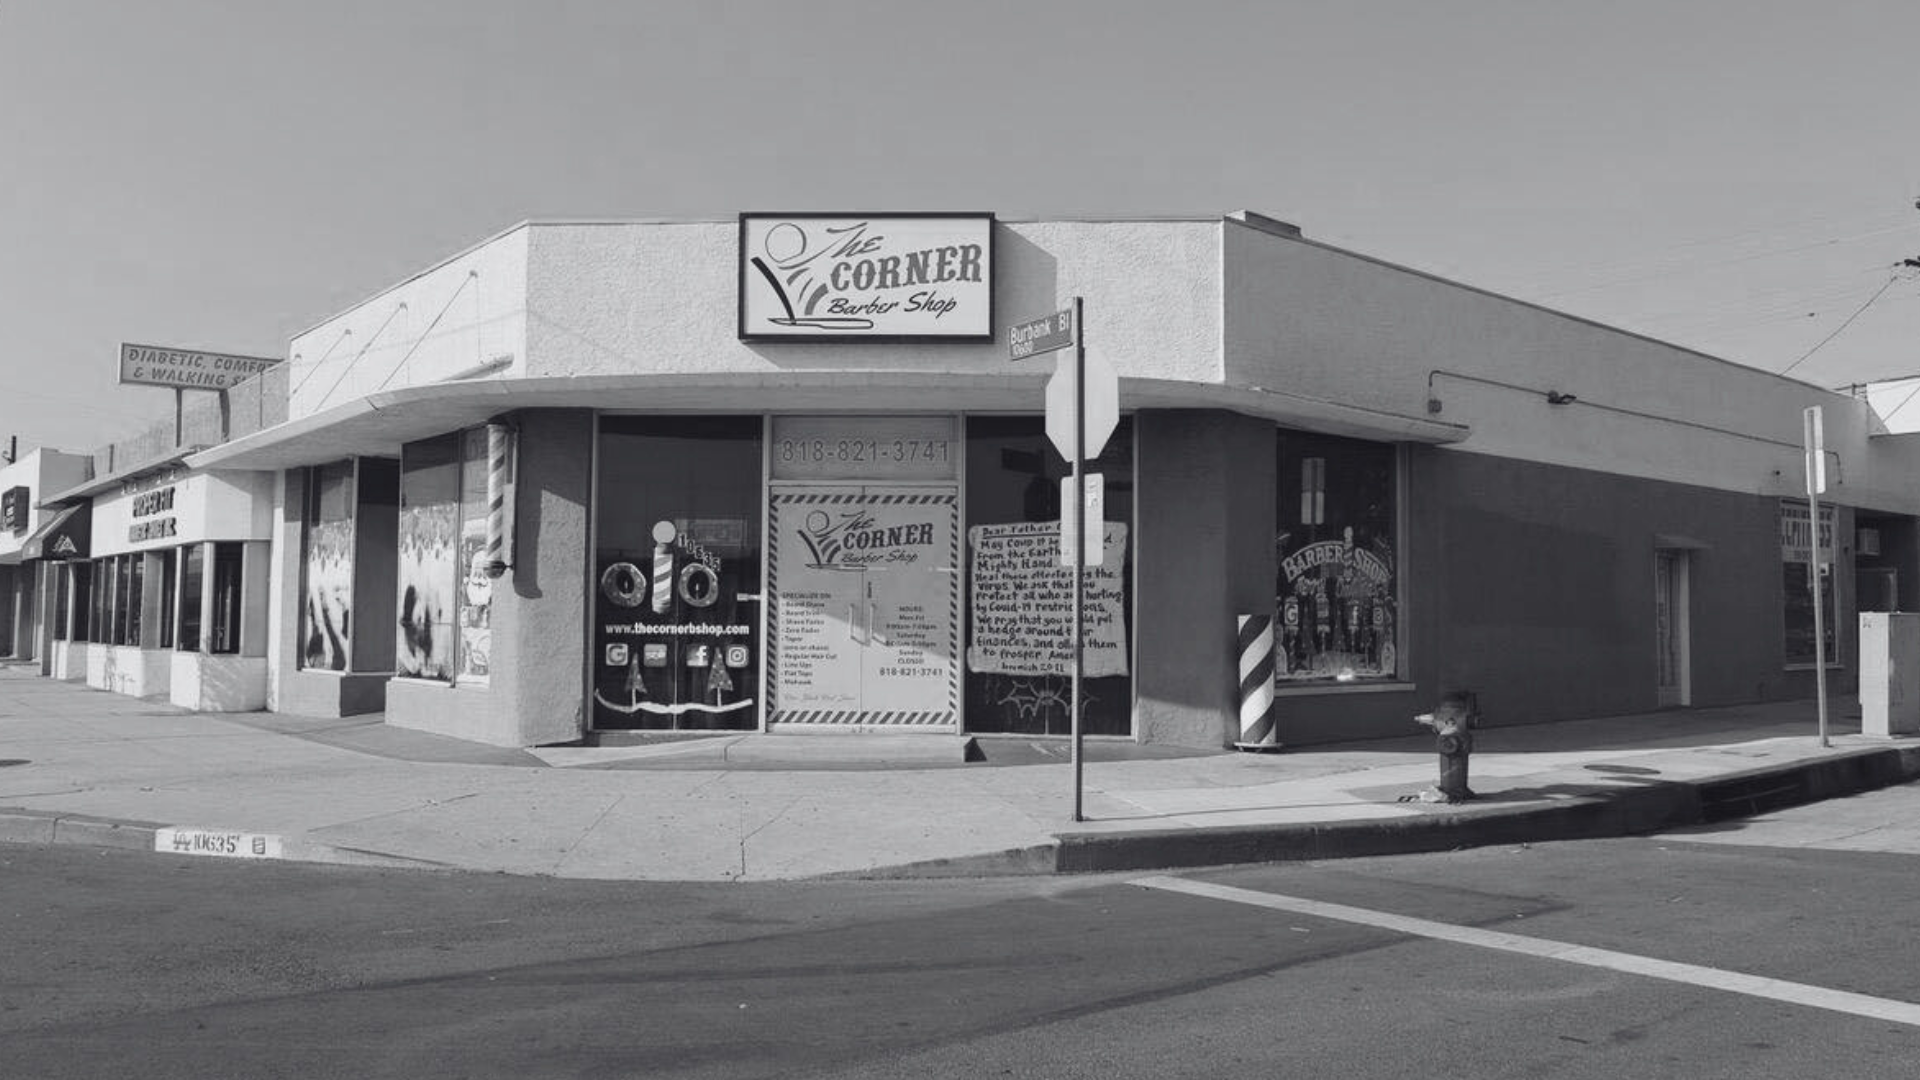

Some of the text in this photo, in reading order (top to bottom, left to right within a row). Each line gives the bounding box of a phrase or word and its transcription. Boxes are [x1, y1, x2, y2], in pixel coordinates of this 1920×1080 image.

[810, 222, 884, 262] The
[830, 243, 982, 291] CORNER
[827, 291, 957, 318] Barber Shop
[1010, 313, 1069, 345] Burbank Bl
[128, 348, 207, 369] DIABETIC,
[133, 367, 144, 378] &
[151, 367, 225, 386] WALKING
[782, 440, 948, 462] 818-821-3741
[833, 510, 875, 532] The
[842, 522, 934, 549] CORNER
[981, 540, 1003, 550] May
[841, 550, 918, 565] Barber Shop
[1008, 549, 1025, 558] the
[977, 560, 1018, 573] Mighty
[1280, 544, 1389, 583] BARBER SHOP
[1096, 568, 1113, 578] the
[1013, 581, 1029, 590] We
[1031, 581, 1048, 589] ask
[1039, 589, 1060, 600] who
[977, 615, 991, 624] We
[1019, 615, 1042, 624] that
[1043, 617, 1062, 626] you
[605, 622, 750, 637] www.thecornerbshop.com
[988, 624, 1021, 638] hedge
[1024, 626, 1063, 636] around
[1033, 639, 1054, 648] and
[1089, 638, 1117, 649] them
[983, 647, 996, 656] to
